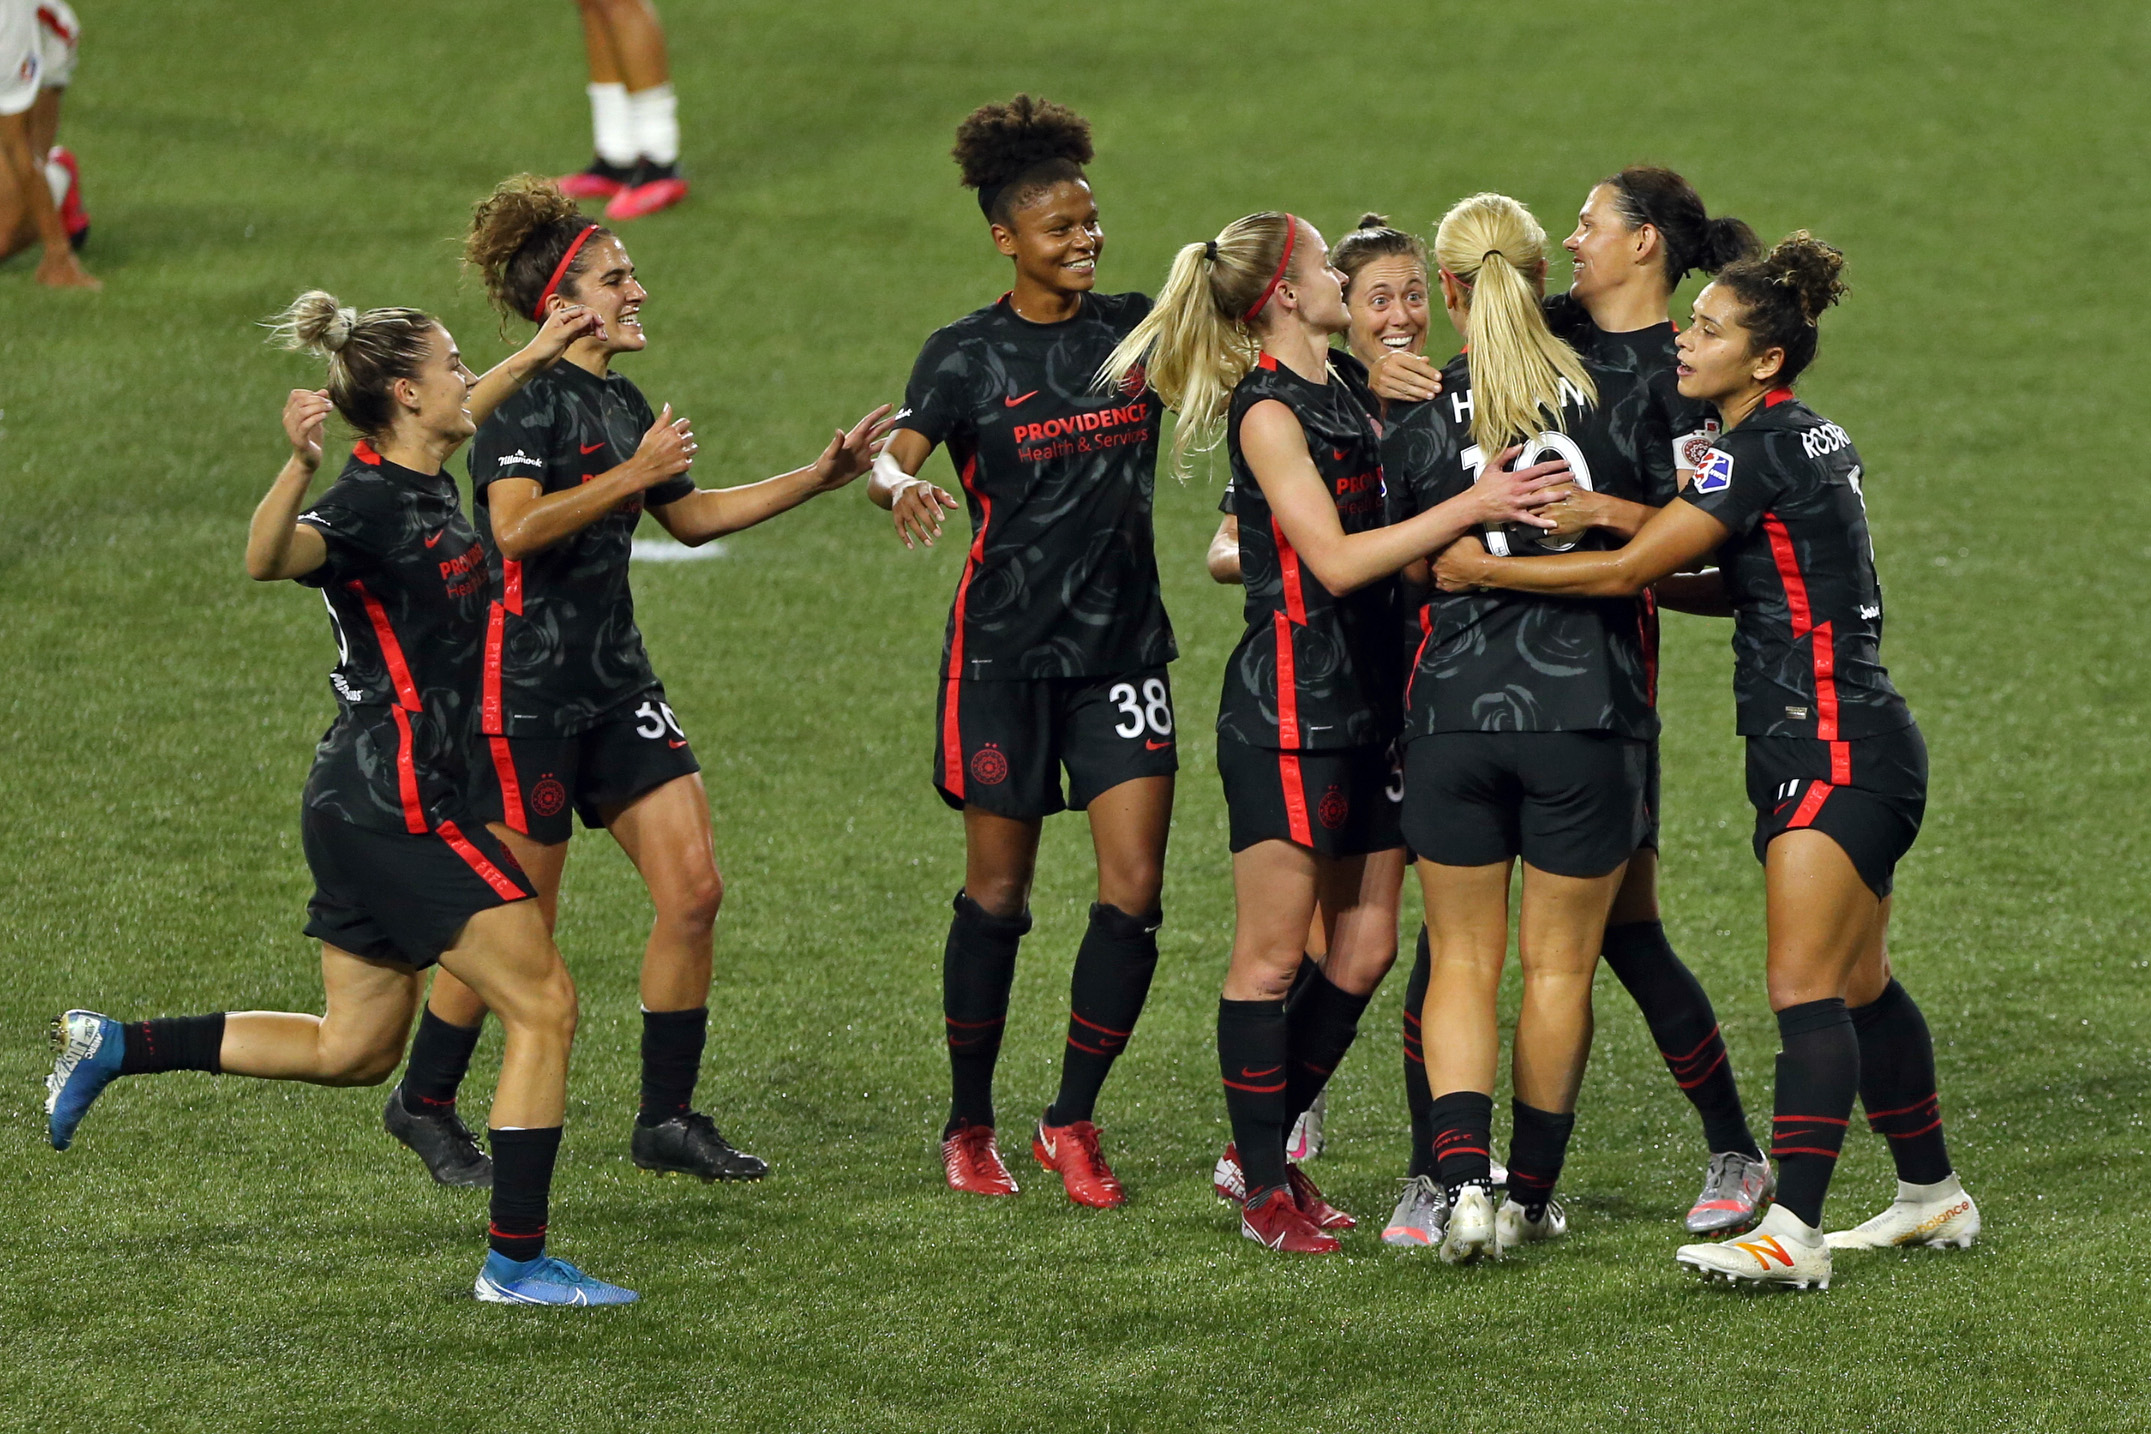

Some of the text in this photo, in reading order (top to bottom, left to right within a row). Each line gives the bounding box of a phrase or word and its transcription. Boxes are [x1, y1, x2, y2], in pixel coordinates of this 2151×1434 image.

[1013, 403, 1148, 443] PROVIDENCE
[498, 454, 543, 468] Tillamook
[1018, 428, 1149, 463] Health & Services
[1461, 430, 1593, 557] 10
[1109, 678, 1172, 738] 38
